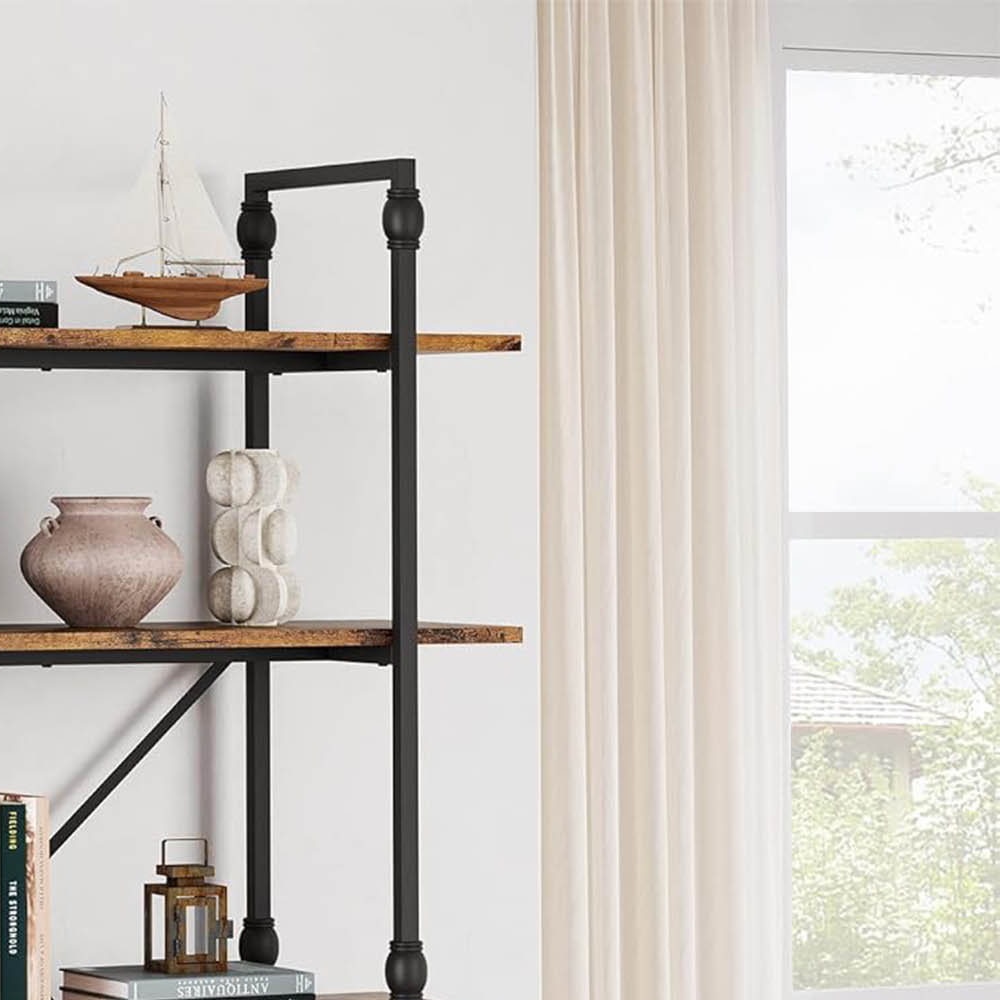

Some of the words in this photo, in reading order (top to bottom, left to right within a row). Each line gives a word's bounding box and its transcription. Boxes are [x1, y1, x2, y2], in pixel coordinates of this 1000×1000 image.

[8, 811, 17, 850] FIELDING
[8, 881, 17, 896] THE
[8, 900, 17, 956] STRONGHOLD
[176, 982, 269, 998] ANTIQUAIRES
